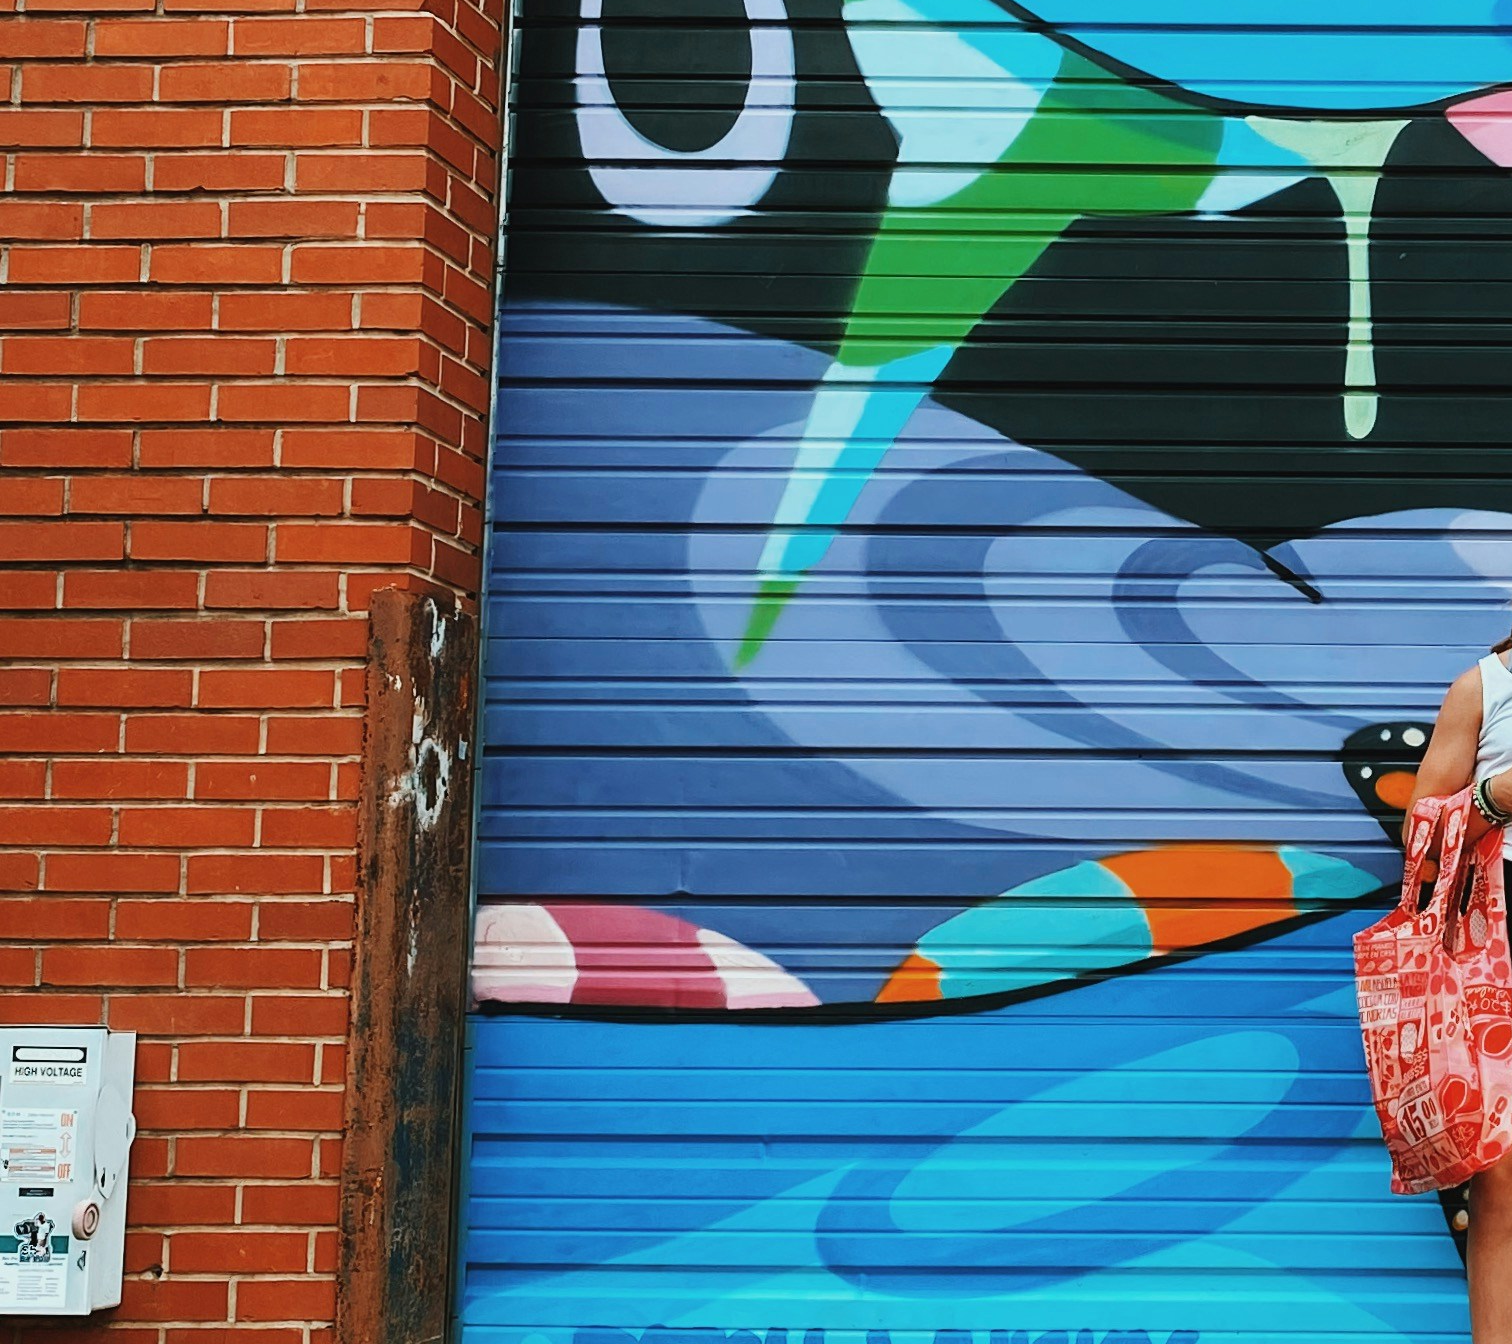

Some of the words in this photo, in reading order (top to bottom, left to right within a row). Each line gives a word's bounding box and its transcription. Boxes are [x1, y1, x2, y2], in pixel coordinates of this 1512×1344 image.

[14, 1066, 38, 1076] HIGH
[40, 1067, 83, 1077] VOLTAGE
[60, 1113, 74, 1127] ON
